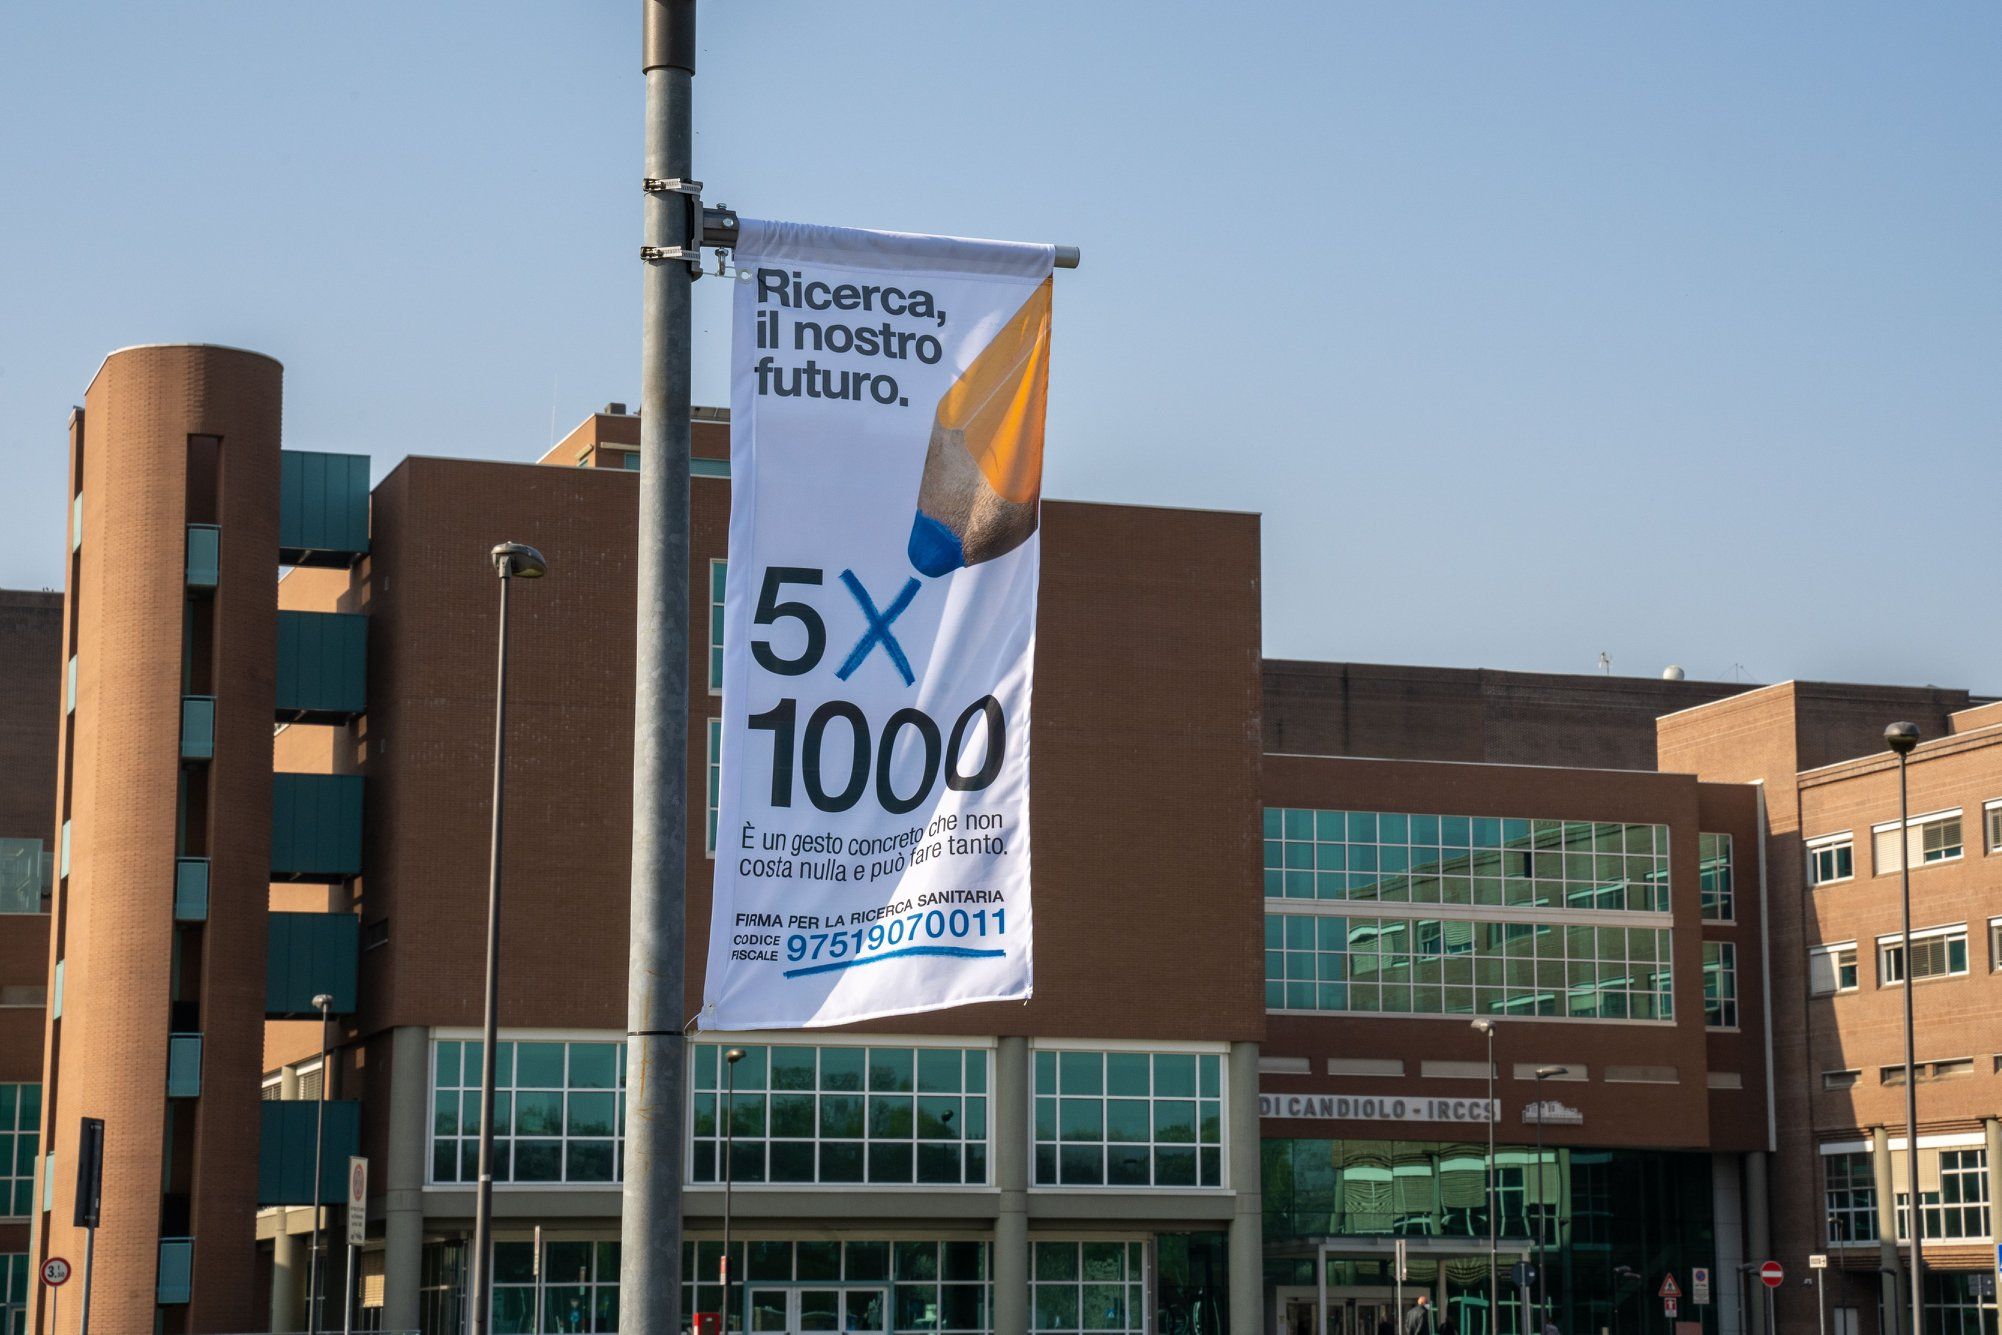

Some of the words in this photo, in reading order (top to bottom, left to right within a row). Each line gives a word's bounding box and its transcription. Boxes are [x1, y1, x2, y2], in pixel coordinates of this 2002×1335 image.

[757, 268, 947, 328] Ricerca,
[756, 310, 779, 349] il
[795, 320, 942, 365] nostro
[755, 357, 909, 407] futuro.
[750, 566, 826, 676] 5
[748, 694, 1006, 814] 1000
[739, 858, 792, 878] costa
[799, 858, 847, 881] nulla
[854, 866, 865, 881] e
[871, 851, 905, 882] può
[910, 841, 942, 867] fare
[948, 835, 1008, 856] tanto.
[741, 822, 755, 849] È
[762, 831, 786, 851] un
[791, 829, 843, 857] gesto
[848, 826, 923, 856] concreto
[928, 813, 957, 837] che
[966, 813, 1003, 830] non
[733, 934, 781, 947] CODICE
[787, 908, 1006, 961] 97519070011
[735, 913, 783, 928] FIRMA
[788, 916, 819, 930] PER
[825, 913, 845, 928] LA
[850, 899, 913, 925] RICERCA
[918, 890, 1004, 907] SANITARIA
[731, 949, 779, 962] FISCALE
[1288, 1097, 1405, 1119] CANDIOLO
